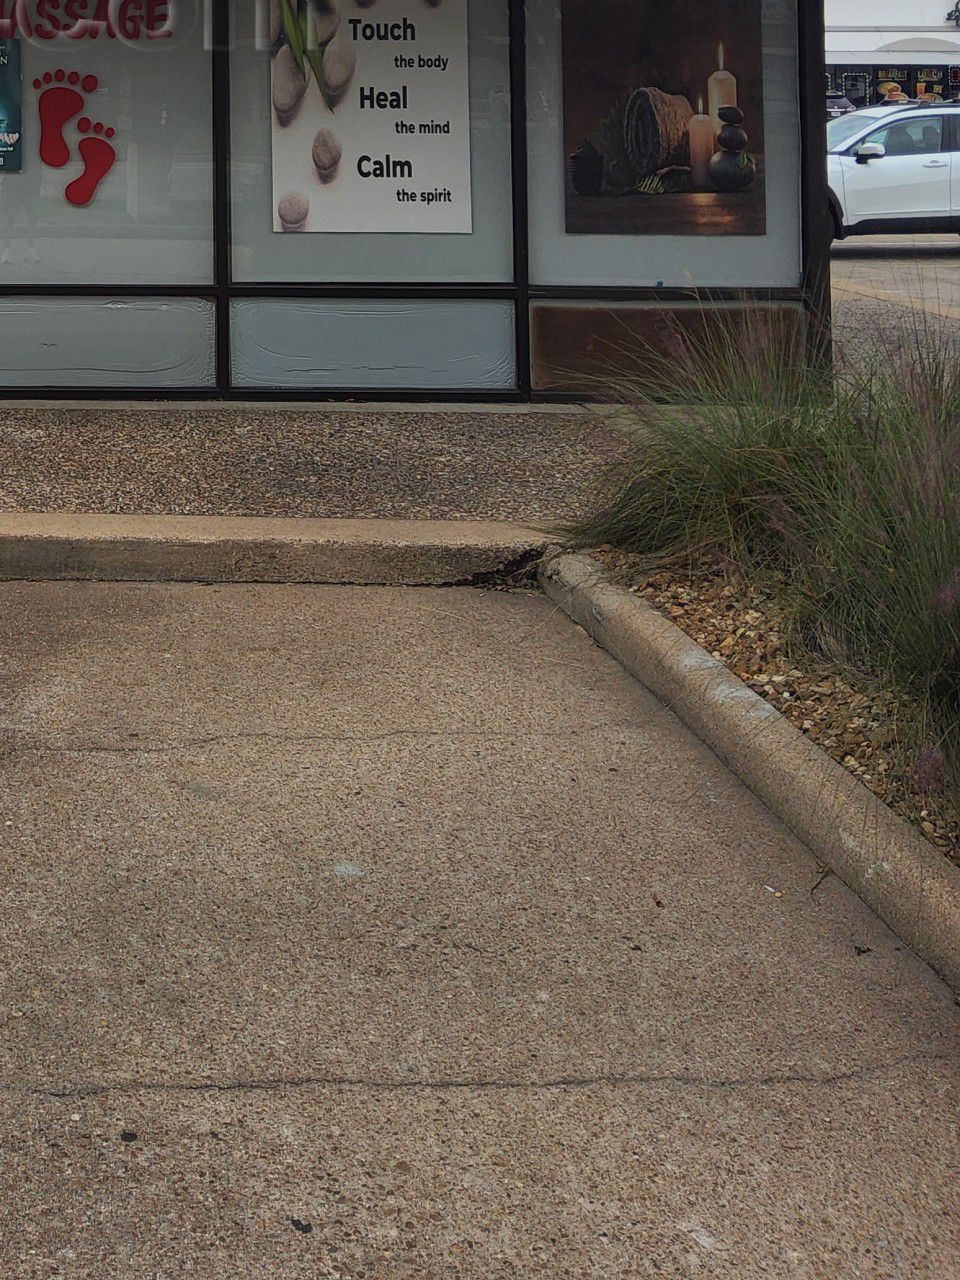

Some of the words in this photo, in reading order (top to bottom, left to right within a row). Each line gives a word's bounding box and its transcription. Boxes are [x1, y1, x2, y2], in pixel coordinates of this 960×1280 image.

[348, 17, 416, 41] Touch
[394, 55, 415, 68] the
[418, 55, 449, 71] body
[359, 86, 408, 109] Heal
[395, 120, 416, 134] the
[419, 120, 450, 134] mind
[357, 155, 412, 178] Calm
[396, 189, 417, 202] the
[420, 188, 452, 205] spirit
